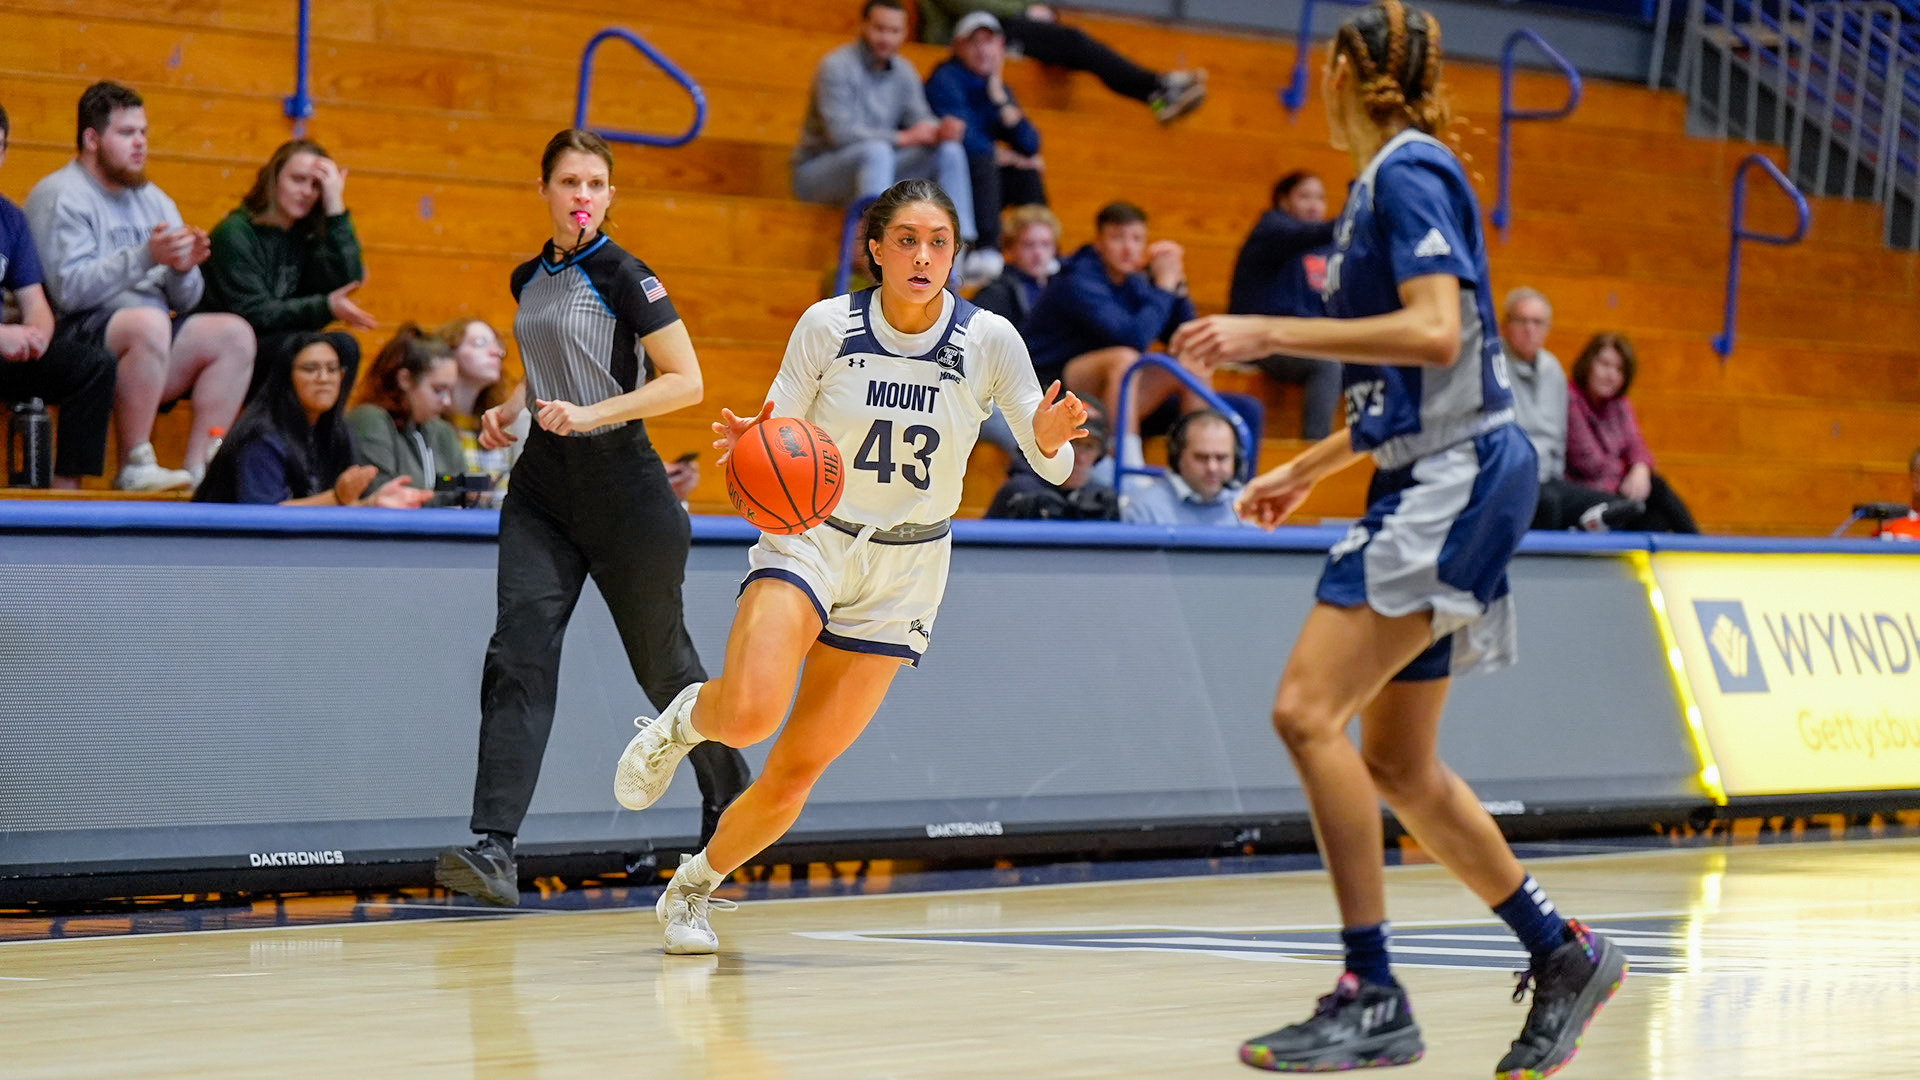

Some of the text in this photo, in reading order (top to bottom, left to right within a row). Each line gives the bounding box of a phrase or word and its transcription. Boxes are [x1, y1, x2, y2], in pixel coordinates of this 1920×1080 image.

[866, 380, 939, 413] MOUNT
[823, 450, 838, 486] THE
[853, 419, 940, 490] 43
[250, 851, 344, 867] DAKTRONICS
